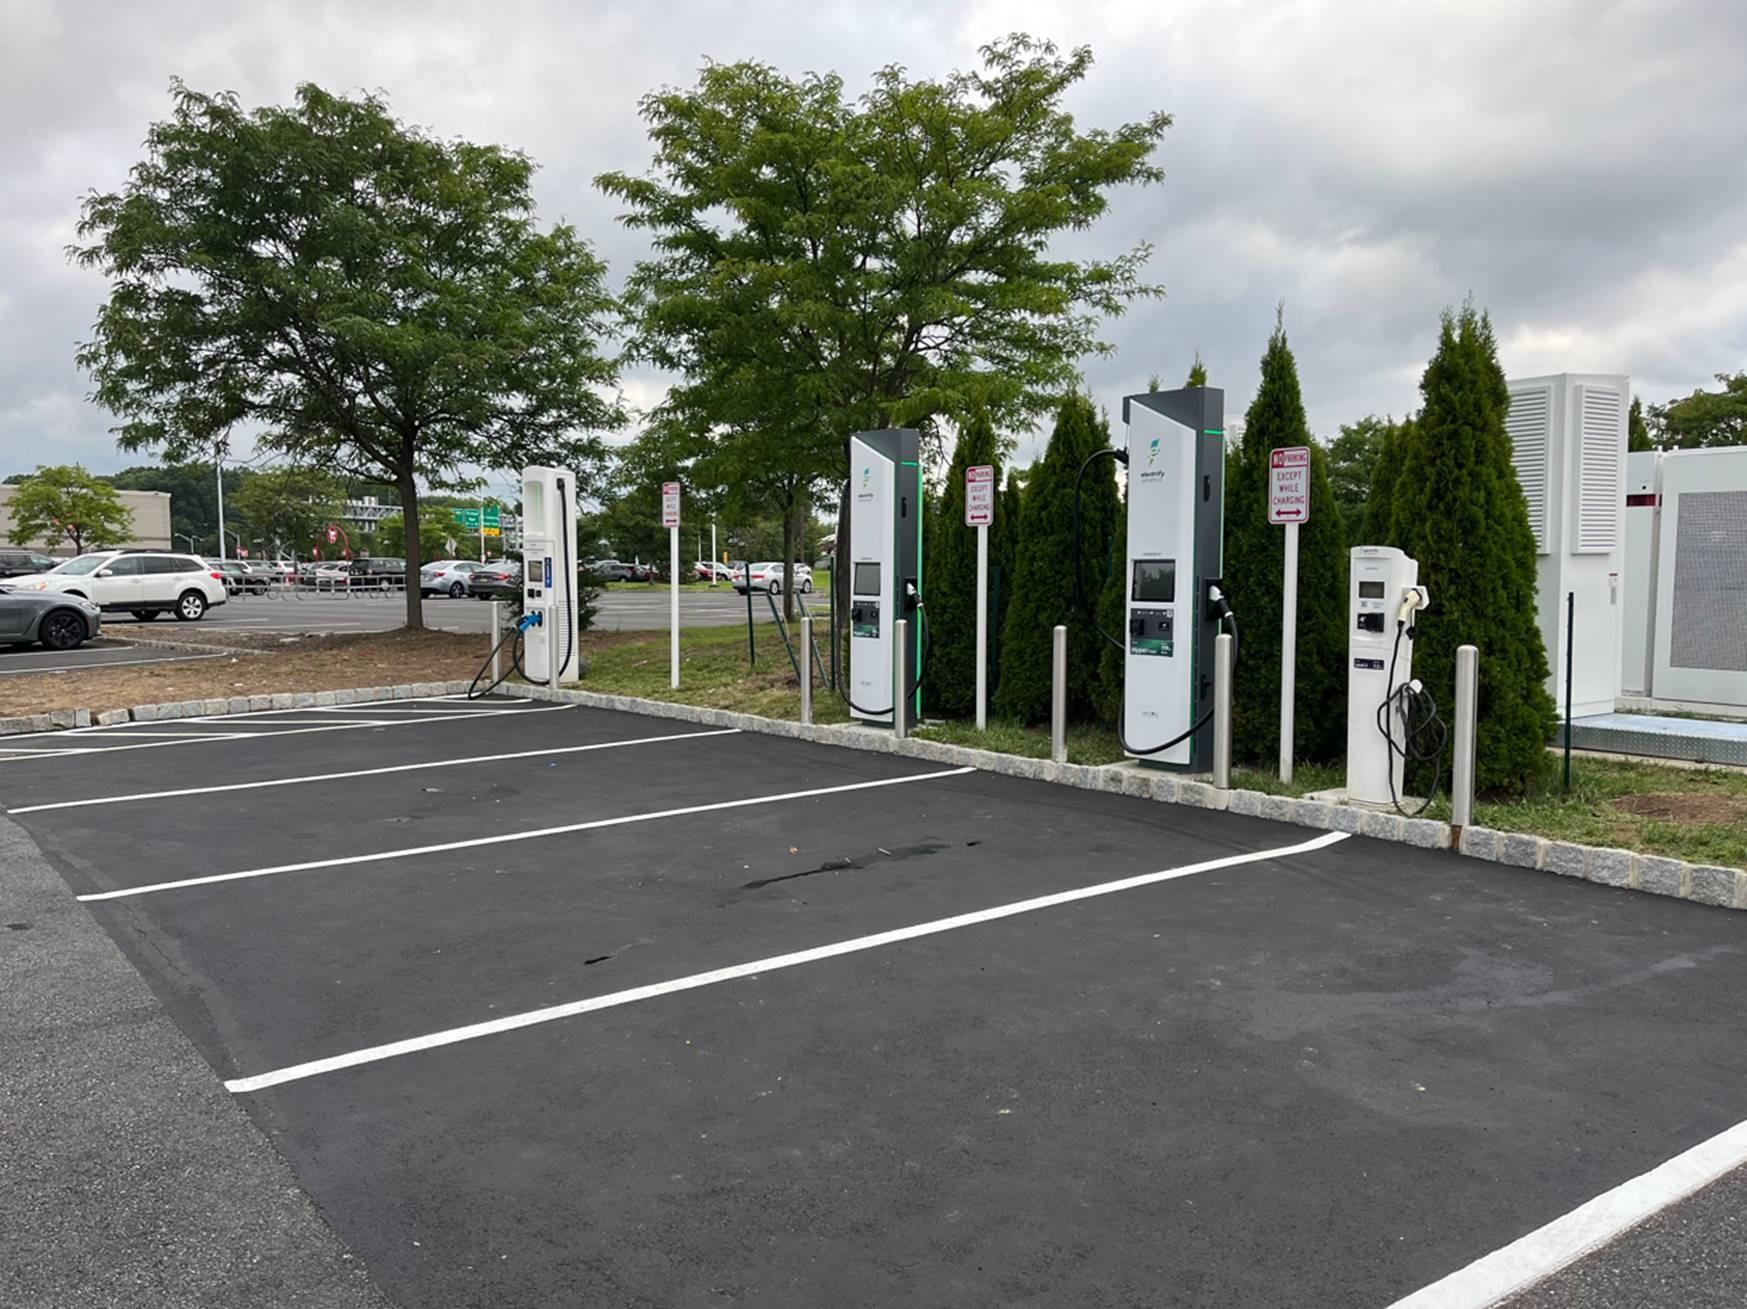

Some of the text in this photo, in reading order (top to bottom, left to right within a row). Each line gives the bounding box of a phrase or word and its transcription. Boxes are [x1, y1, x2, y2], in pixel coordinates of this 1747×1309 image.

[1277, 471, 1302, 481] EXCEPT
[1279, 483, 1299, 493] WHILE
[1273, 495, 1305, 506] CHARGING
